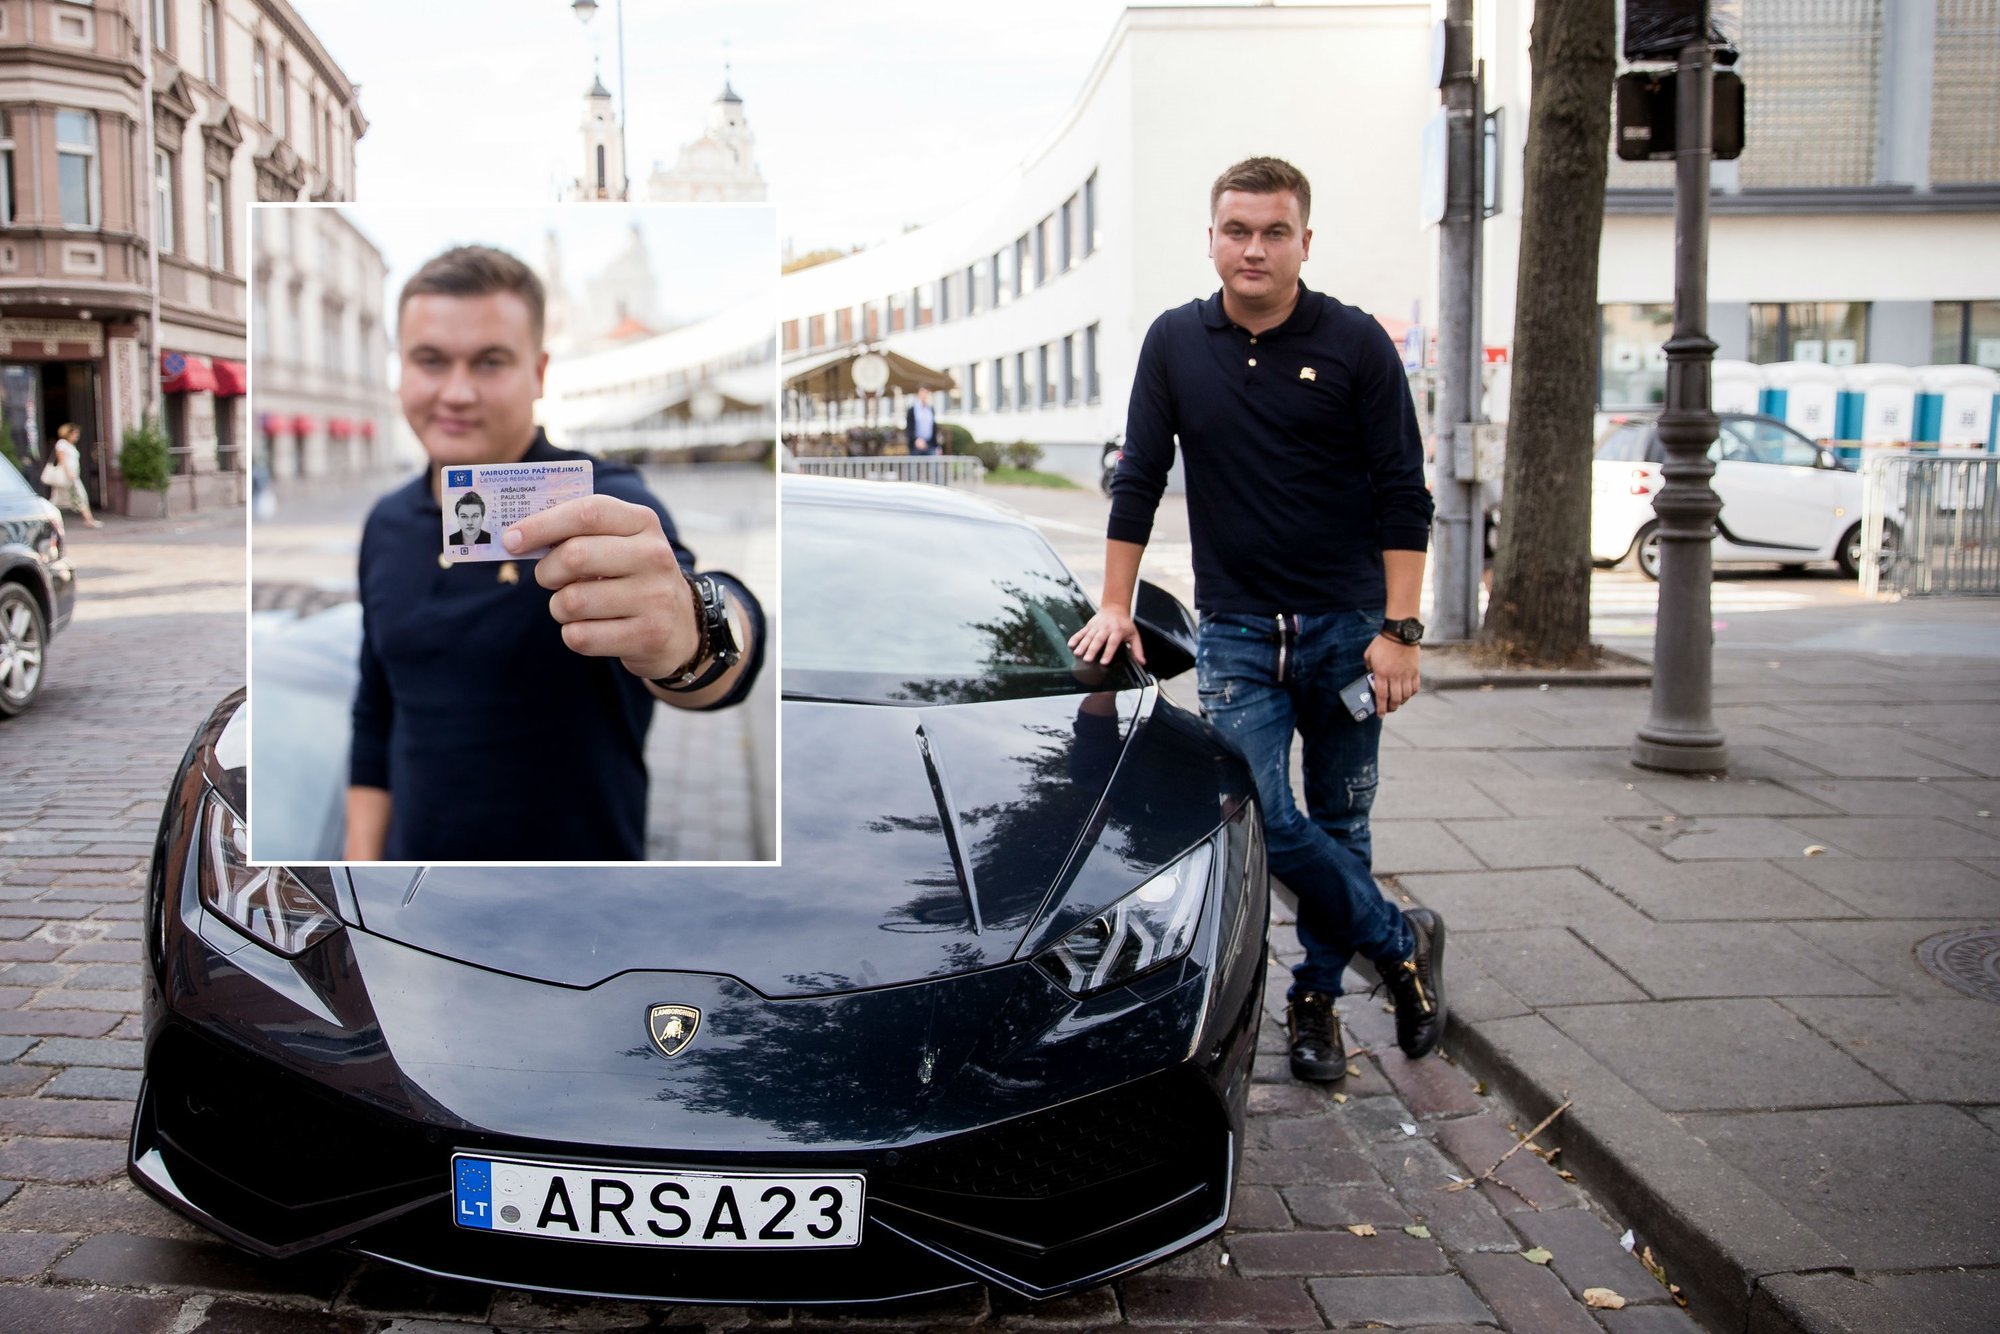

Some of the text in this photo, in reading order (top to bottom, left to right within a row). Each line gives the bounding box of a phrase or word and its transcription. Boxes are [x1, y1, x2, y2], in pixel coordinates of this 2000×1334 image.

[654, 1008, 696, 1018] LAMBORGHINI
[461, 1200, 488, 1217] LT
[536, 1175, 844, 1241] ARSA23
